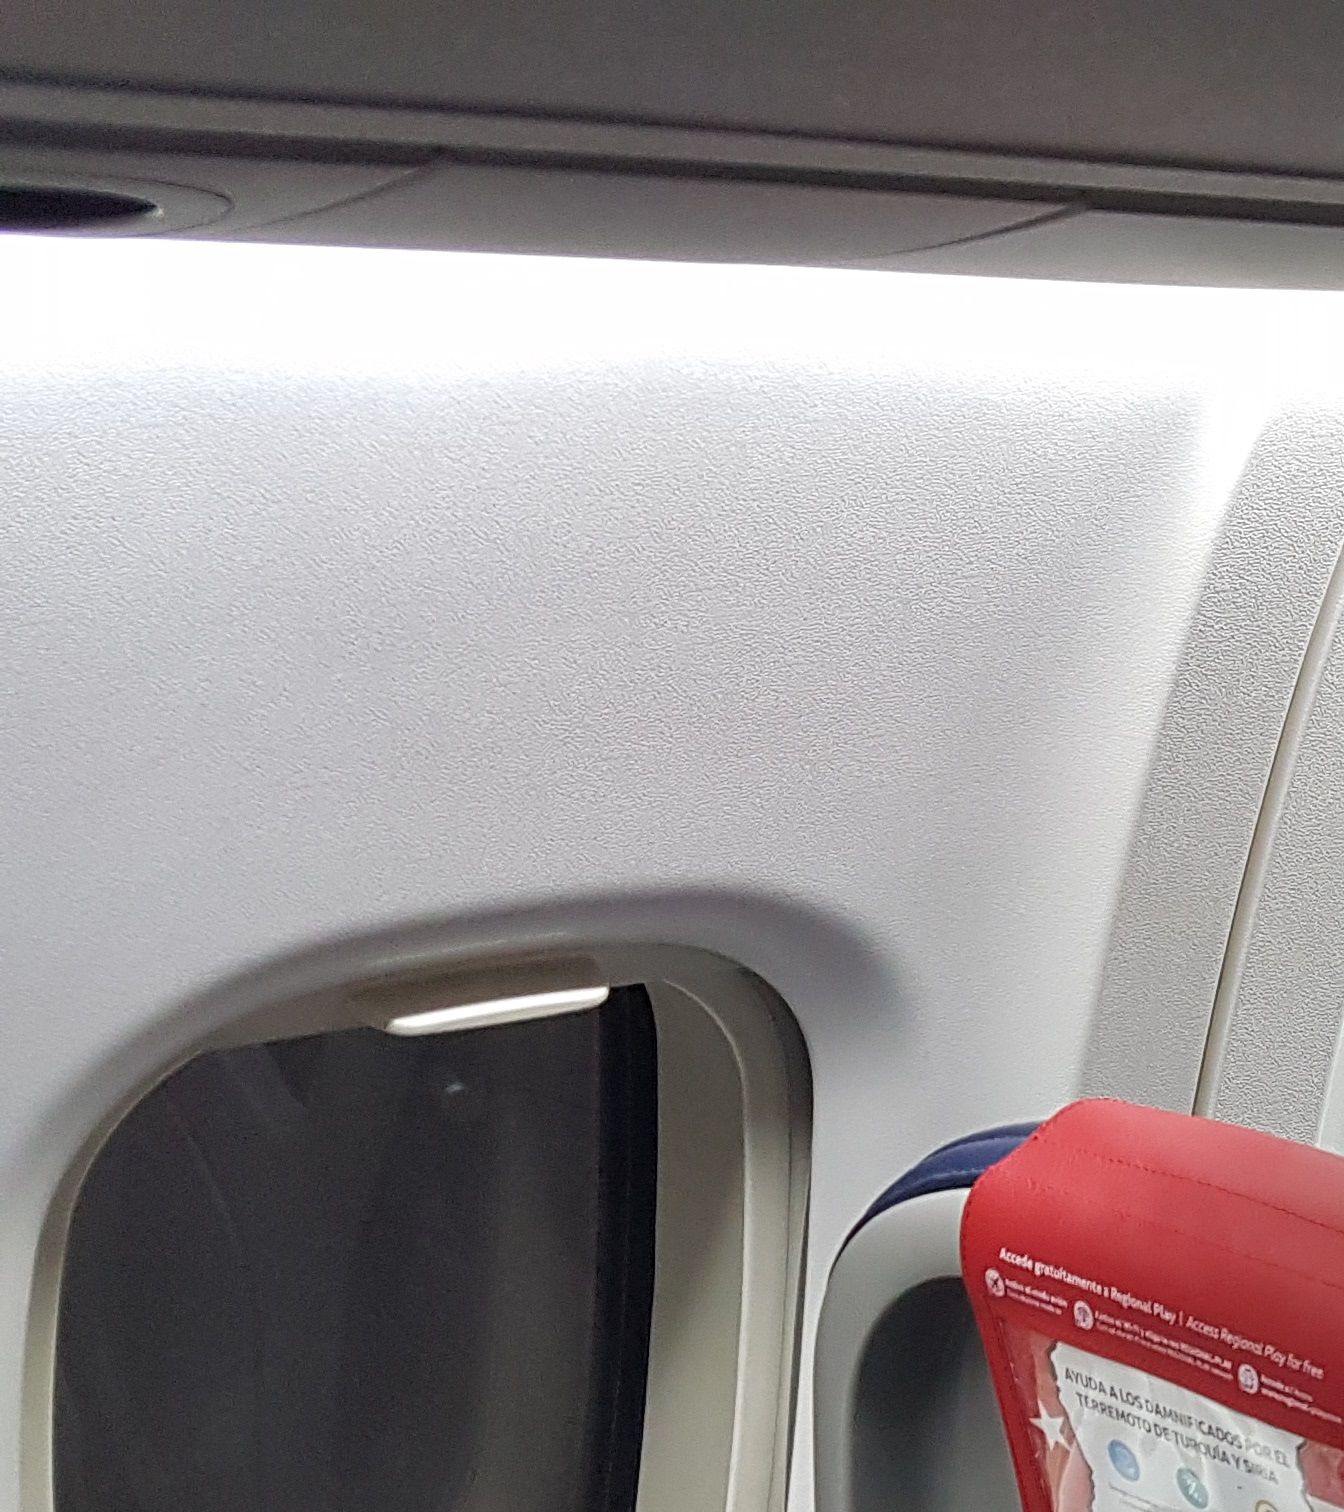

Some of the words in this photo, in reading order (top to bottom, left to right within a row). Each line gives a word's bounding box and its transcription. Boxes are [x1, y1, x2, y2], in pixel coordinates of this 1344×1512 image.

[997, 1244, 1034, 1271] Accede
[1108, 1284, 1154, 1318] Regional
[1151, 1300, 1178, 1327] Play
[1184, 1313, 1220, 1340] Access
[1261, 1342, 1288, 1369] Play
[1300, 1357, 1325, 1381] free
[1063, 1366, 1107, 1395] AYUDA
[1106, 1384, 1118, 1400] A
[1117, 1387, 1144, 1410] LOS
[1075, 1391, 1152, 1434] TERREMOTO
[1151, 1421, 1172, 1442] DE
[1230, 1453, 1244, 1471] Y
